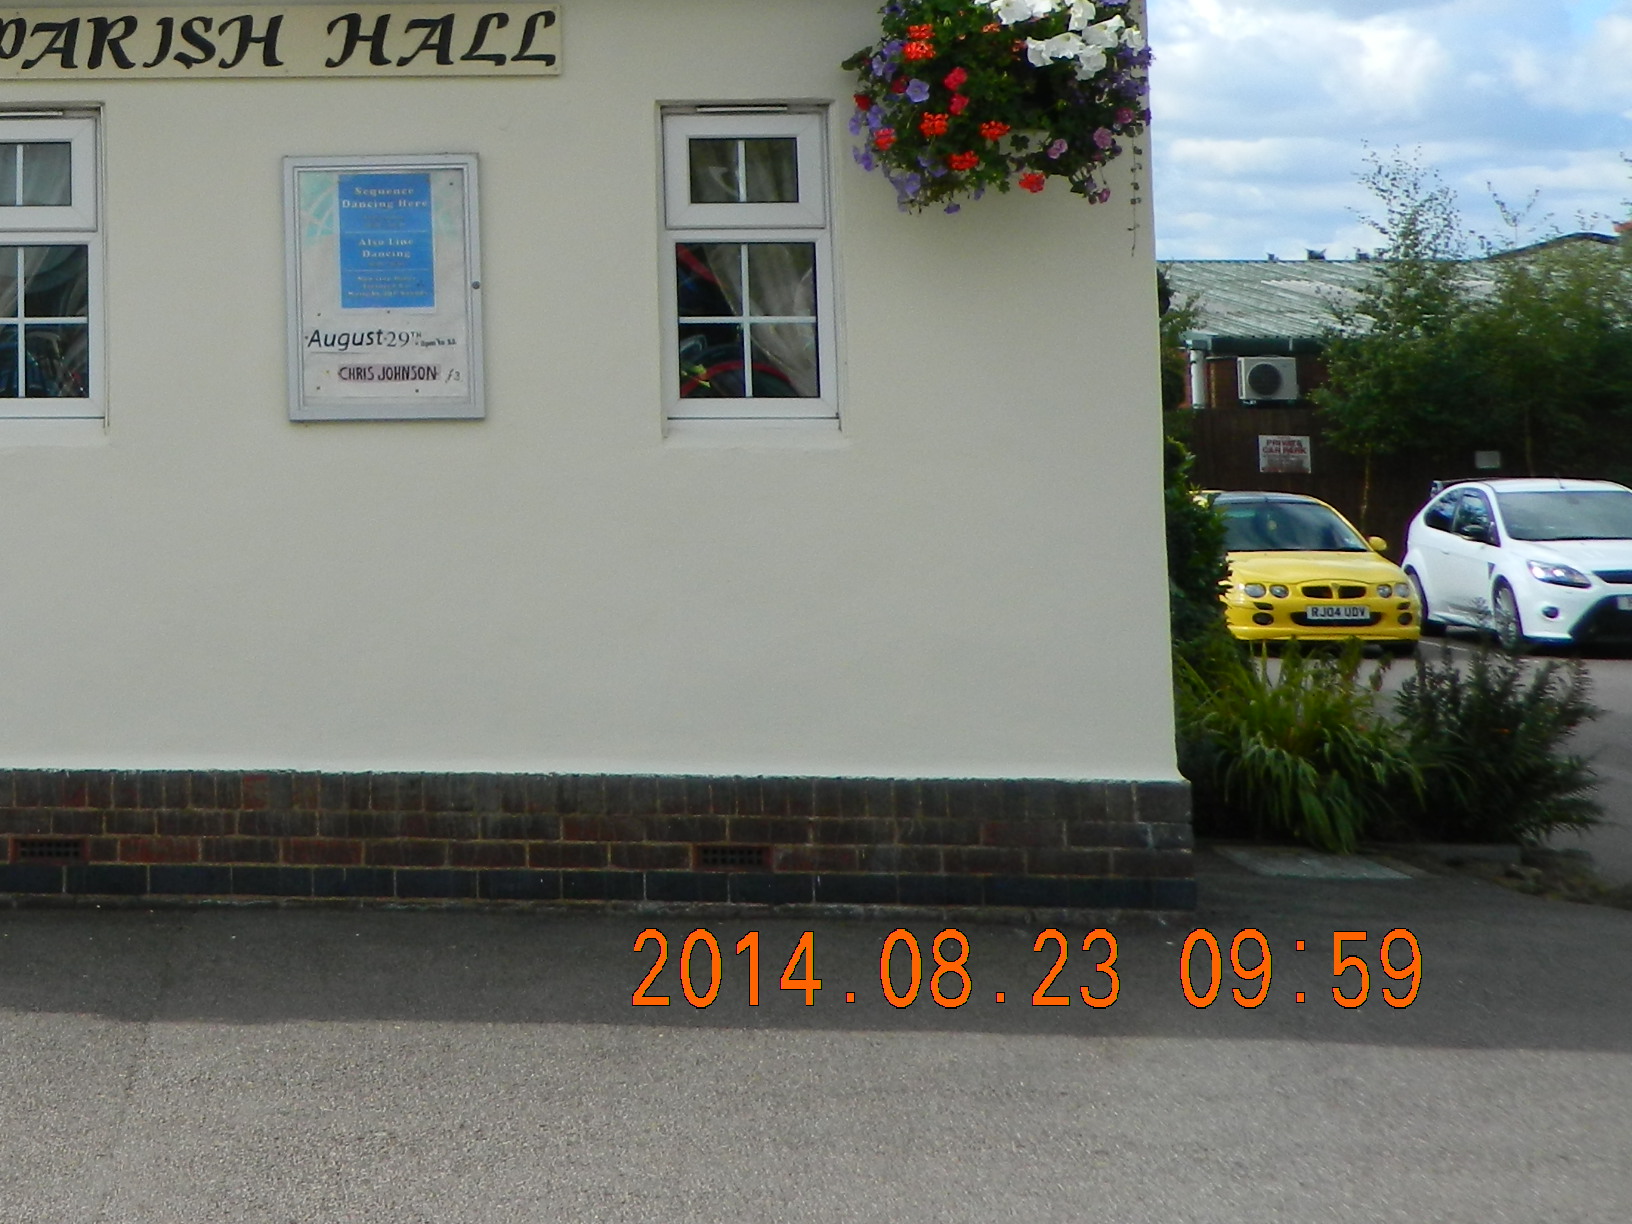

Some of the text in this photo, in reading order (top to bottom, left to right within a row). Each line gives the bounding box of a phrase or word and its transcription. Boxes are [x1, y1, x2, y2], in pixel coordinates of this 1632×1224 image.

[324, 11, 556, 68] HALL
[354, 187, 414, 197] Sequence
[342, 199, 428, 209] Dancing Here
[362, 249, 411, 259] Dancing
[307, 328, 383, 351] August
[338, 365, 373, 382] CHRIS
[377, 365, 437, 382] JOHNSON
[1311, 606, 1342, 617] RJ04
